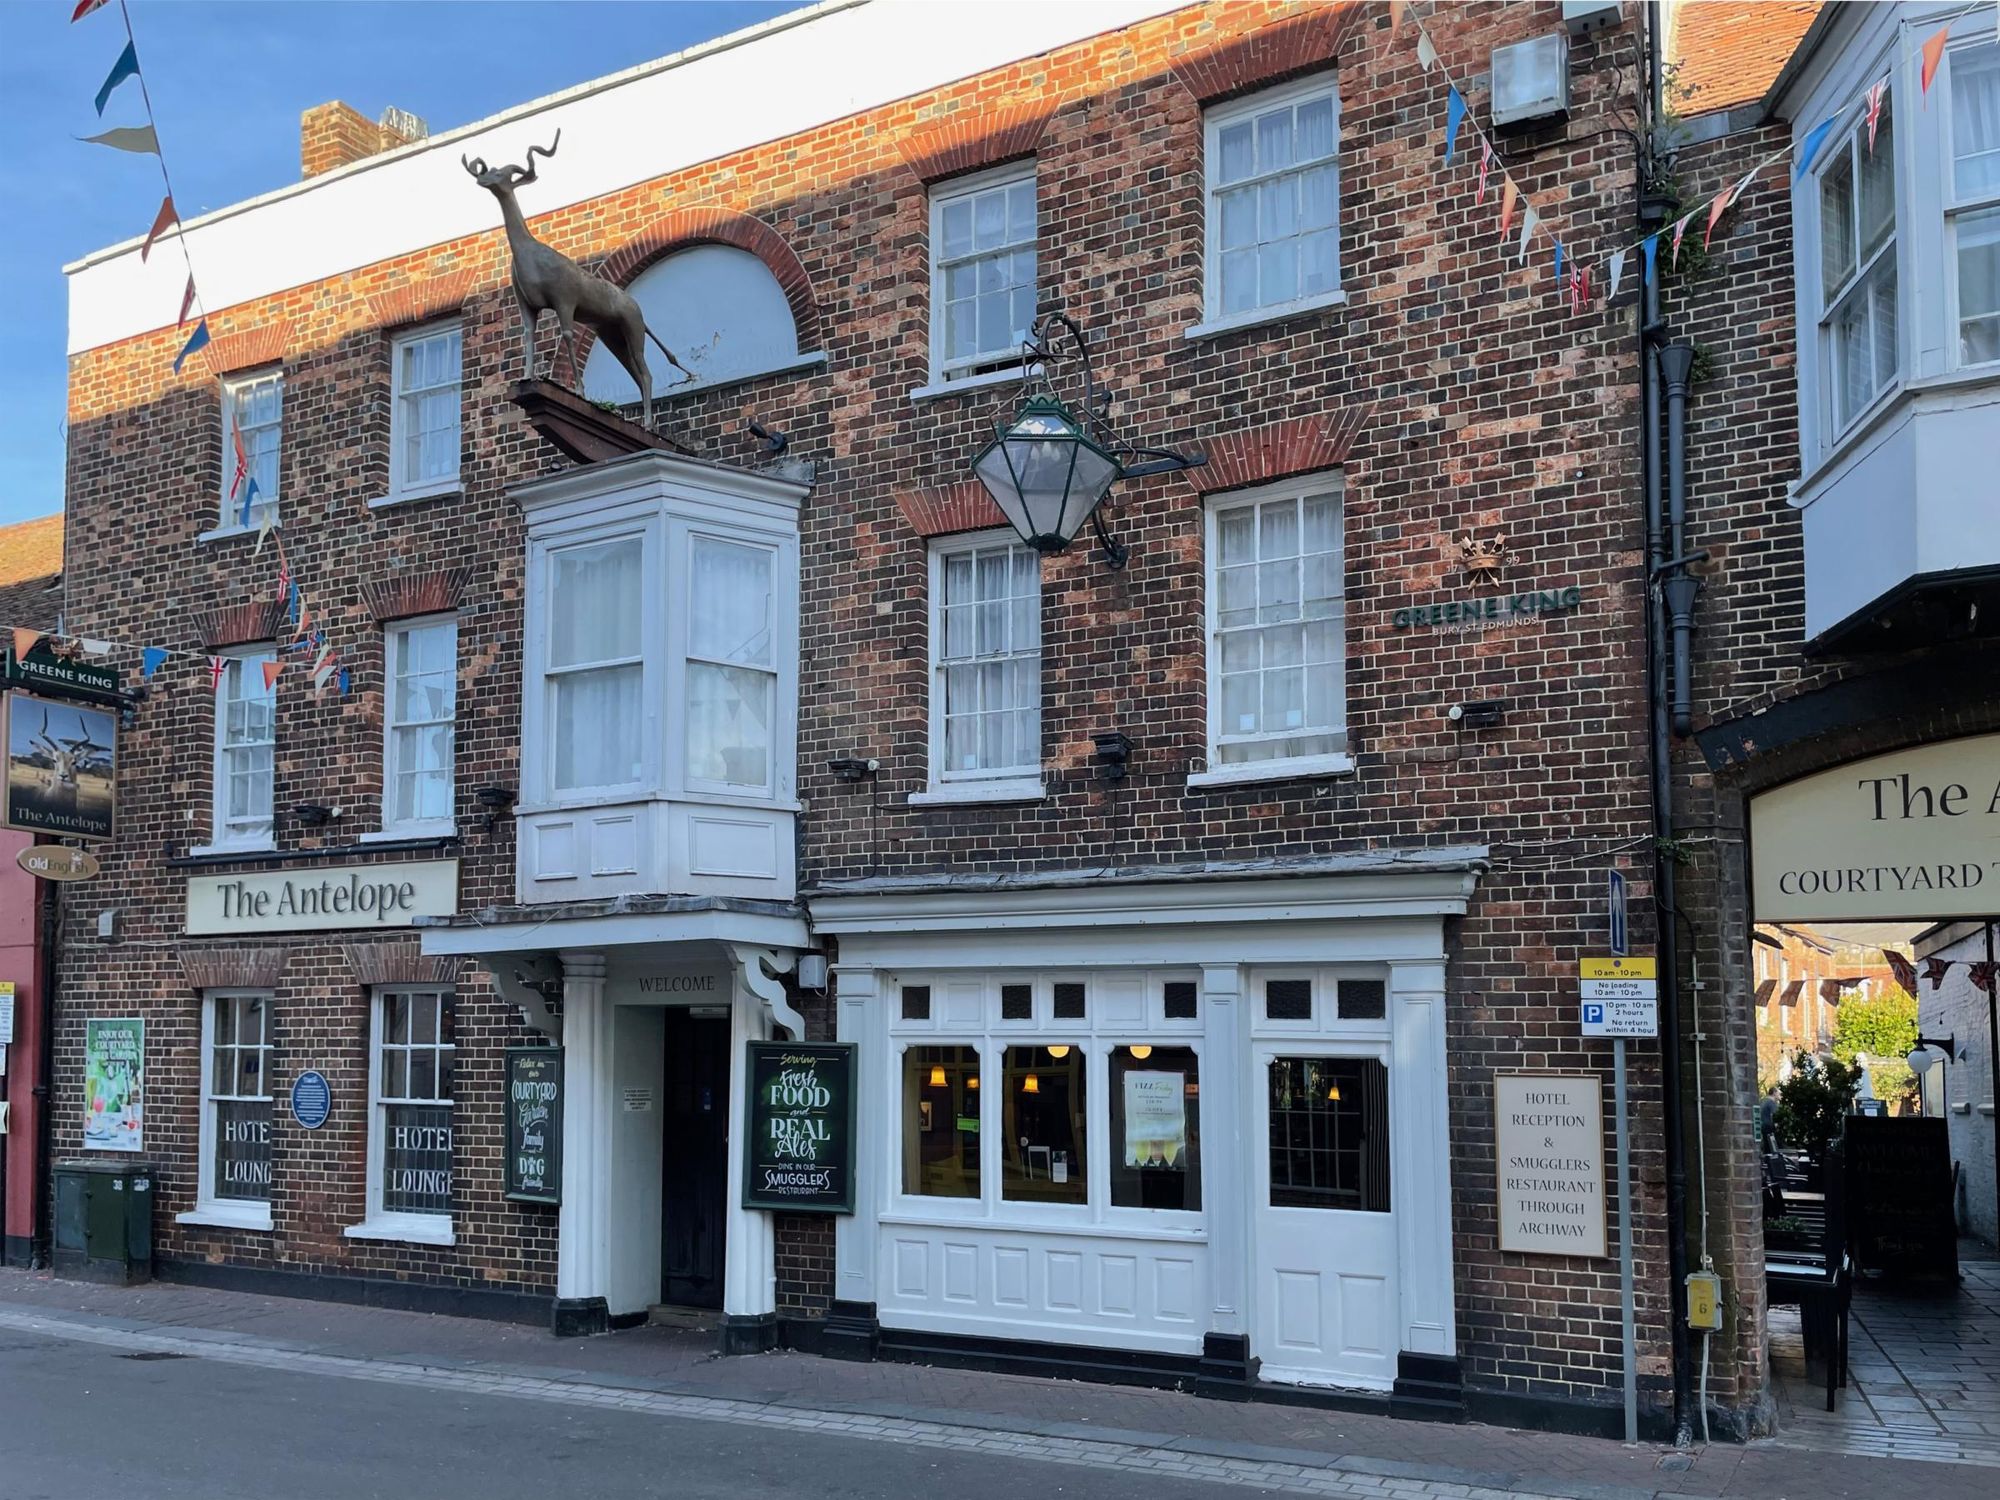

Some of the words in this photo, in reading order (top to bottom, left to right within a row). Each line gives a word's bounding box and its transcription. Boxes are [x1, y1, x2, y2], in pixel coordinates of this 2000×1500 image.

[1506, 556, 1520, 566] 99
[1392, 597, 1498, 628] GREENE
[1510, 586, 1581, 615] KING
[1432, 625, 1461, 636] BURY
[1465, 621, 1477, 632] ST
[1482, 617, 1538, 631] EDMUNDS
[19, 661, 74, 680] GREENE
[78, 673, 113, 689] KING
[1858, 773, 1969, 820] The
[16, 807, 42, 822] The
[45, 812, 107, 831] Antelope
[1779, 863, 1983, 895] COURTYARD
[218, 880, 269, 918] The
[277, 874, 415, 921] Antelope
[639, 976, 715, 992] WELCOME
[1611, 981, 1638, 989] loading
[780, 1053, 817, 1068] Serving
[780, 1069, 818, 1089] Fresh
[512, 1080, 557, 1102] COURTYARD
[770, 1085, 831, 1107] FOOD
[1526, 1092, 1570, 1105] HOTEL
[790, 1107, 810, 1116] and
[1512, 1114, 1585, 1127] RECEPTION
[225, 1121, 270, 1143] HOTE
[770, 1118, 831, 1140] REAL
[774, 1130, 816, 1160] Ales
[1543, 1136, 1554, 1148] &
[225, 1160, 272, 1184] LOUNG
[803, 1163, 816, 1171] OUR
[1509, 1156, 1591, 1171] SMUGGLERS
[765, 1169, 830, 1190] SMUGGLERS
[1506, 1178, 1596, 1193] RESTAURANT
[778, 1186, 819, 1195] RESTAURANT
[1518, 1200, 1585, 1215] THROUGH
[1518, 1221, 1586, 1237] ARCHWAY
